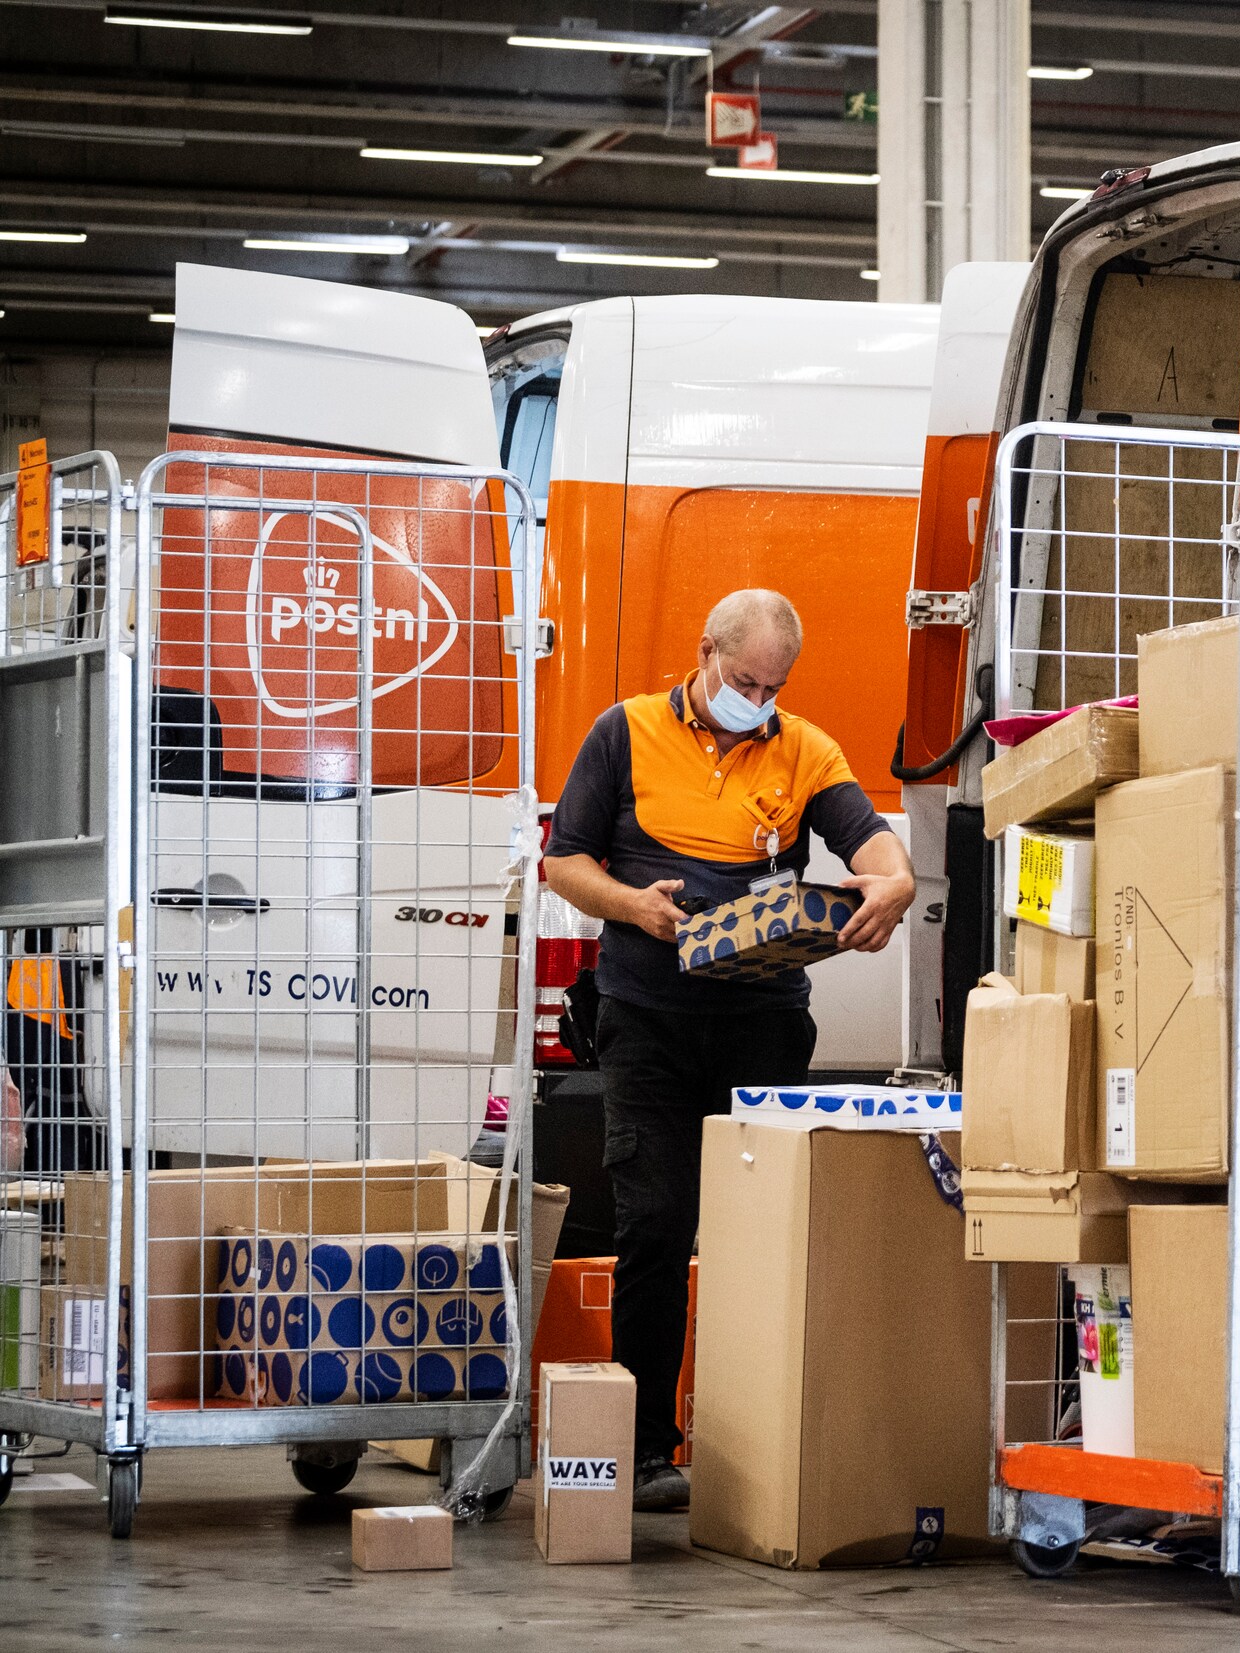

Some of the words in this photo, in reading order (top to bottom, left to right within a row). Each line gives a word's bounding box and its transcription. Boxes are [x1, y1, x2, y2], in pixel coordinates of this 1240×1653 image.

[1157, 345, 1179, 403] A
[1114, 885, 1124, 981] Tronios
[549, 1461, 617, 1480] WAYS
